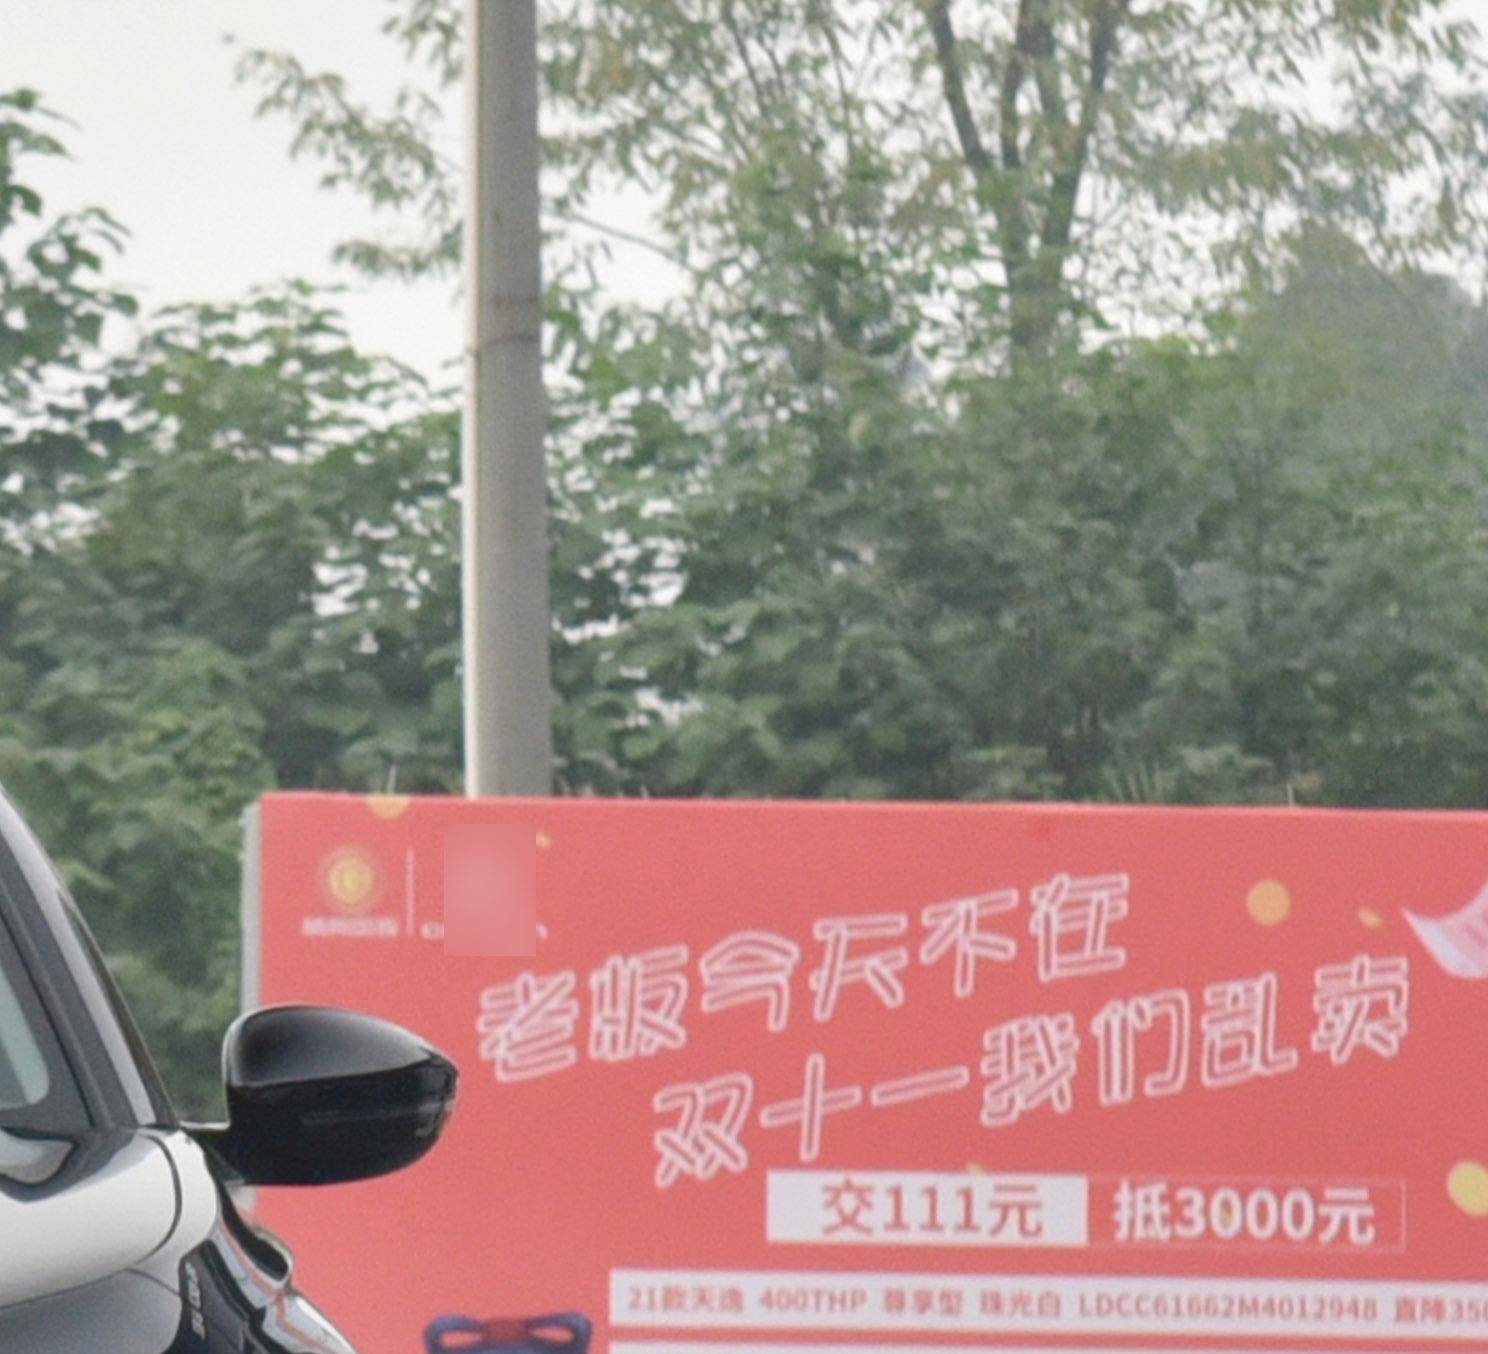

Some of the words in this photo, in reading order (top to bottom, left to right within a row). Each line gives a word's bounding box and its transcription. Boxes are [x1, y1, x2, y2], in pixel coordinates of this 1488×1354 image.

[476, 872, 1130, 1083] 老板今天不在
[655, 954, 1410, 1189] 双十一我们乱卖
[821, 1178, 1044, 1240] 交111元
[1113, 1181, 1376, 1246] 抵3000元
[759, 1286, 867, 1315] 400THP
[1078, 1292, 1378, 1322] LDCC61662M4012948
